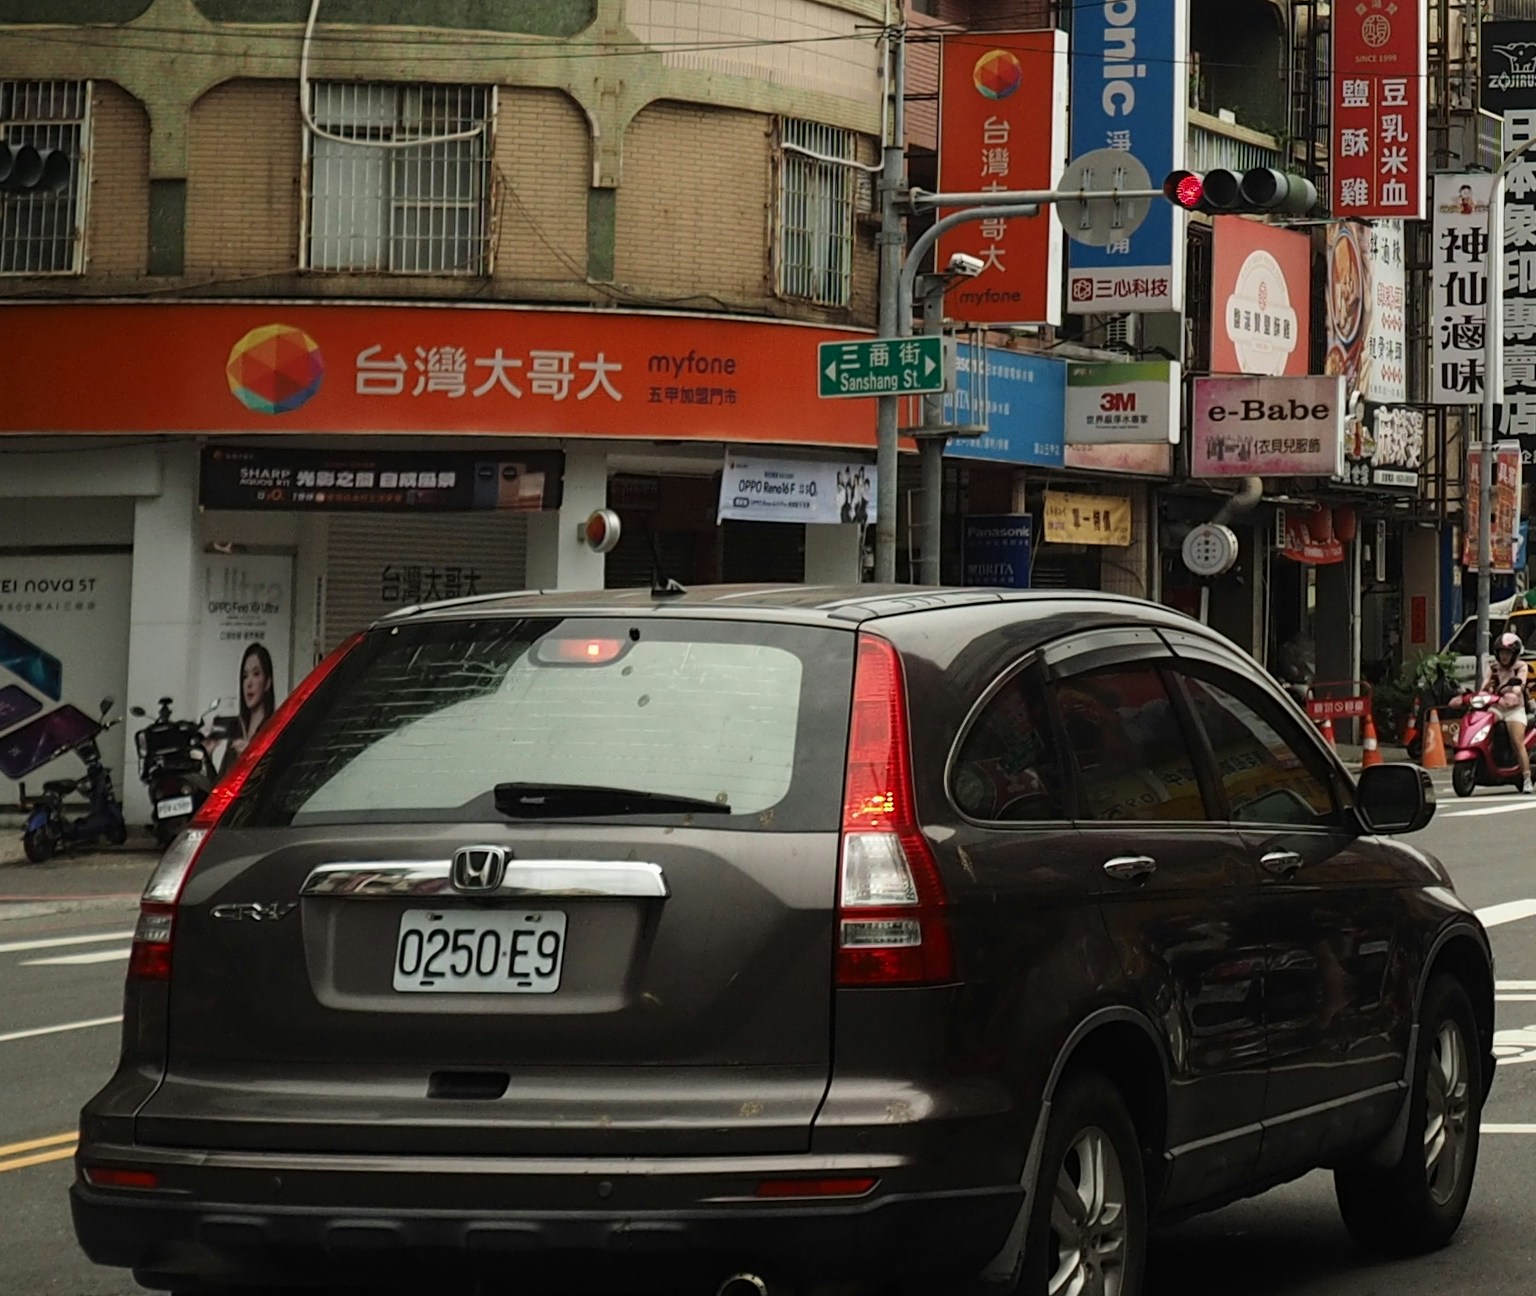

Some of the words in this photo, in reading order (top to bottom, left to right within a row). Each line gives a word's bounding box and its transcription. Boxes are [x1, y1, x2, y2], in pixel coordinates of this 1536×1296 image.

[1340, 78, 1370, 207] 鹽酥雞
[1380, 78, 1409, 206] 豆乳米血
[959, 287, 1022, 305] myfone
[1096, 278, 1168, 298] 三心科技
[1439, 227, 1488, 396] 神仙滷味
[648, 350, 737, 378] myfone
[840, 342, 921, 369] 三商街
[355, 343, 624, 402] 台灣大哥大
[840, 370, 898, 392] Sanshang
[903, 369, 921, 388] St.
[648, 387, 737, 405] 五甲加盟門市
[1100, 392, 1136, 412] 3M
[1208, 399, 1330, 422] e-Babe
[24, 579, 74, 592] nova
[379, 565, 482, 604] 台灣大哥大
